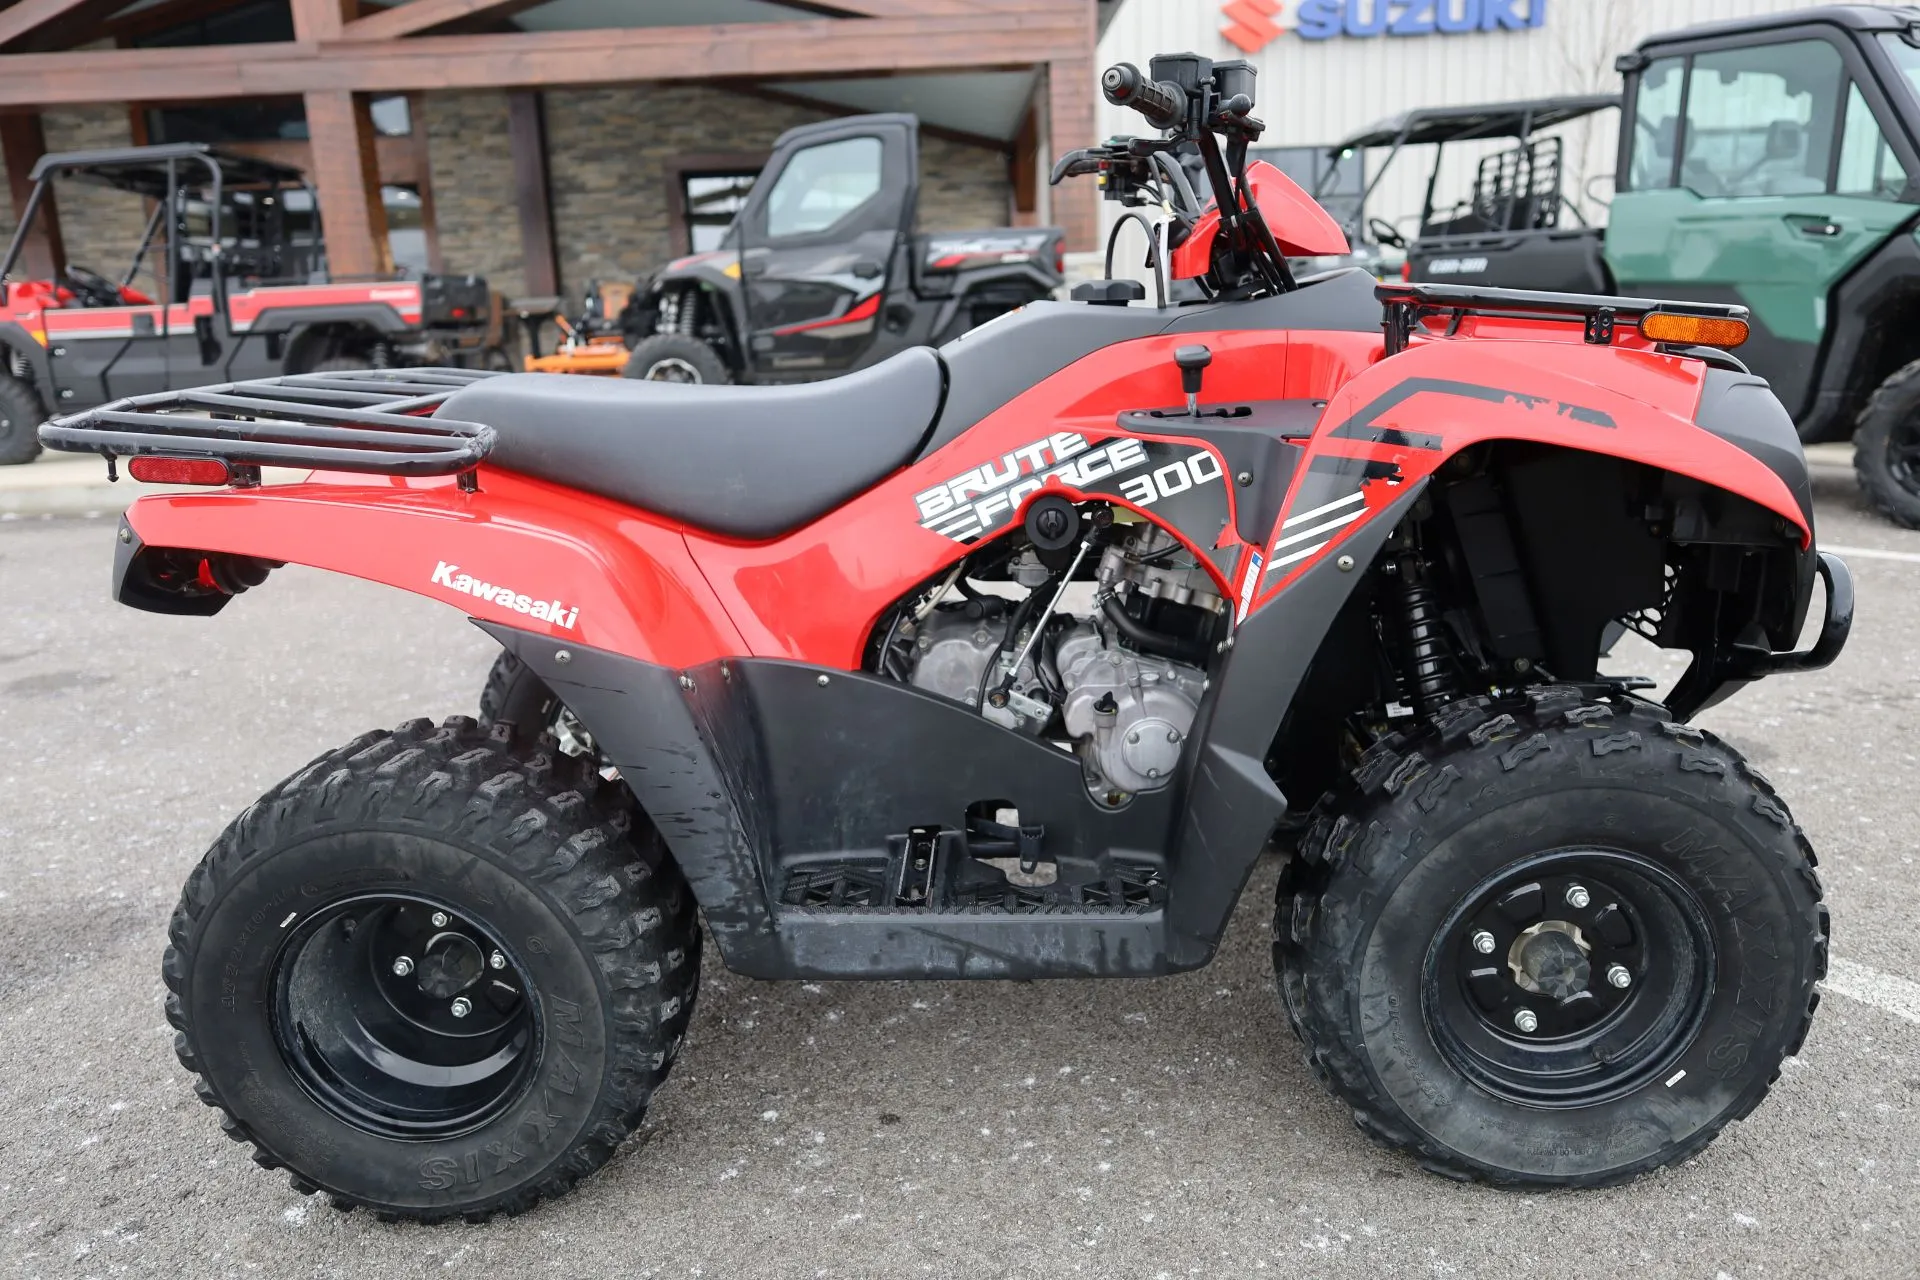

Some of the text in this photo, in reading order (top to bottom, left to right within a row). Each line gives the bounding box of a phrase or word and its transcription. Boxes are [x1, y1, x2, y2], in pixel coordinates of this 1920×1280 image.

[1295, 0, 1544, 40] SUZUKI
[916, 431, 1089, 519] BRUTE
[971, 437, 1149, 527] FORCE
[1119, 450, 1224, 507] 300
[430, 560, 580, 630] Kawasaki
[1661, 827, 1778, 1079] MAXXIS
[418, 994, 584, 1190] MAXXIS
